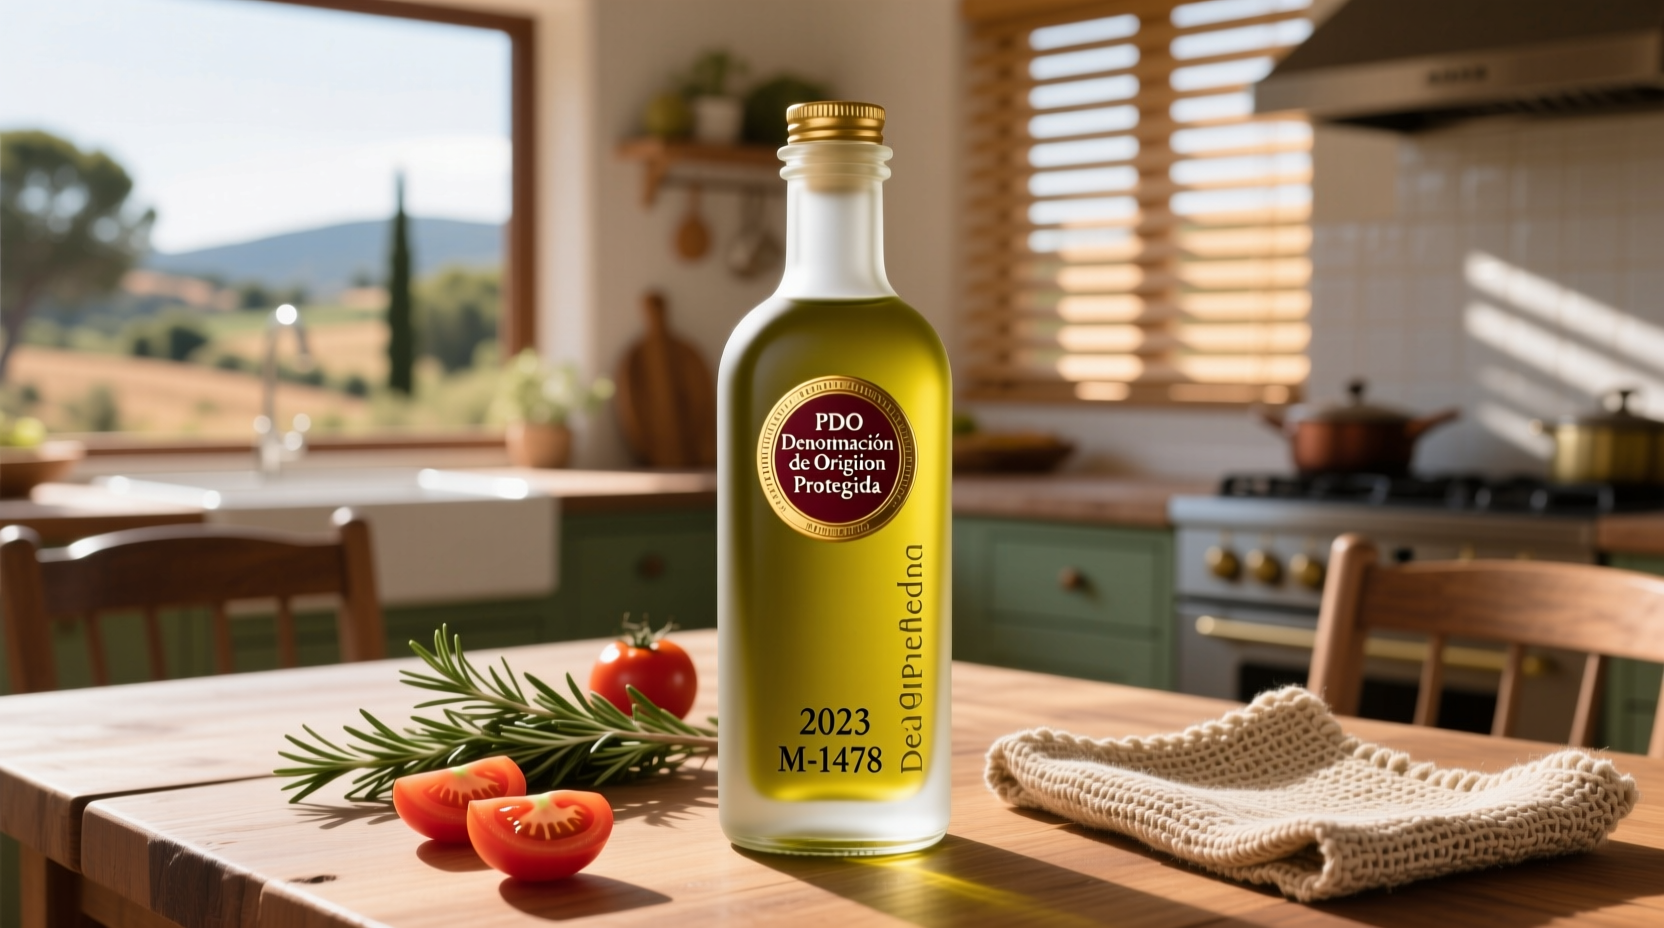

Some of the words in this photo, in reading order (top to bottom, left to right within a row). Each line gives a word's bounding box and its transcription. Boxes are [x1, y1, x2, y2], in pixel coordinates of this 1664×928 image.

[815, 412, 864, 431] PDO
[788, 453, 811, 471] de
[794, 475, 882, 500] Protegida
[799, 707, 870, 736] 2023
[777, 745, 882, 773] M-1478
